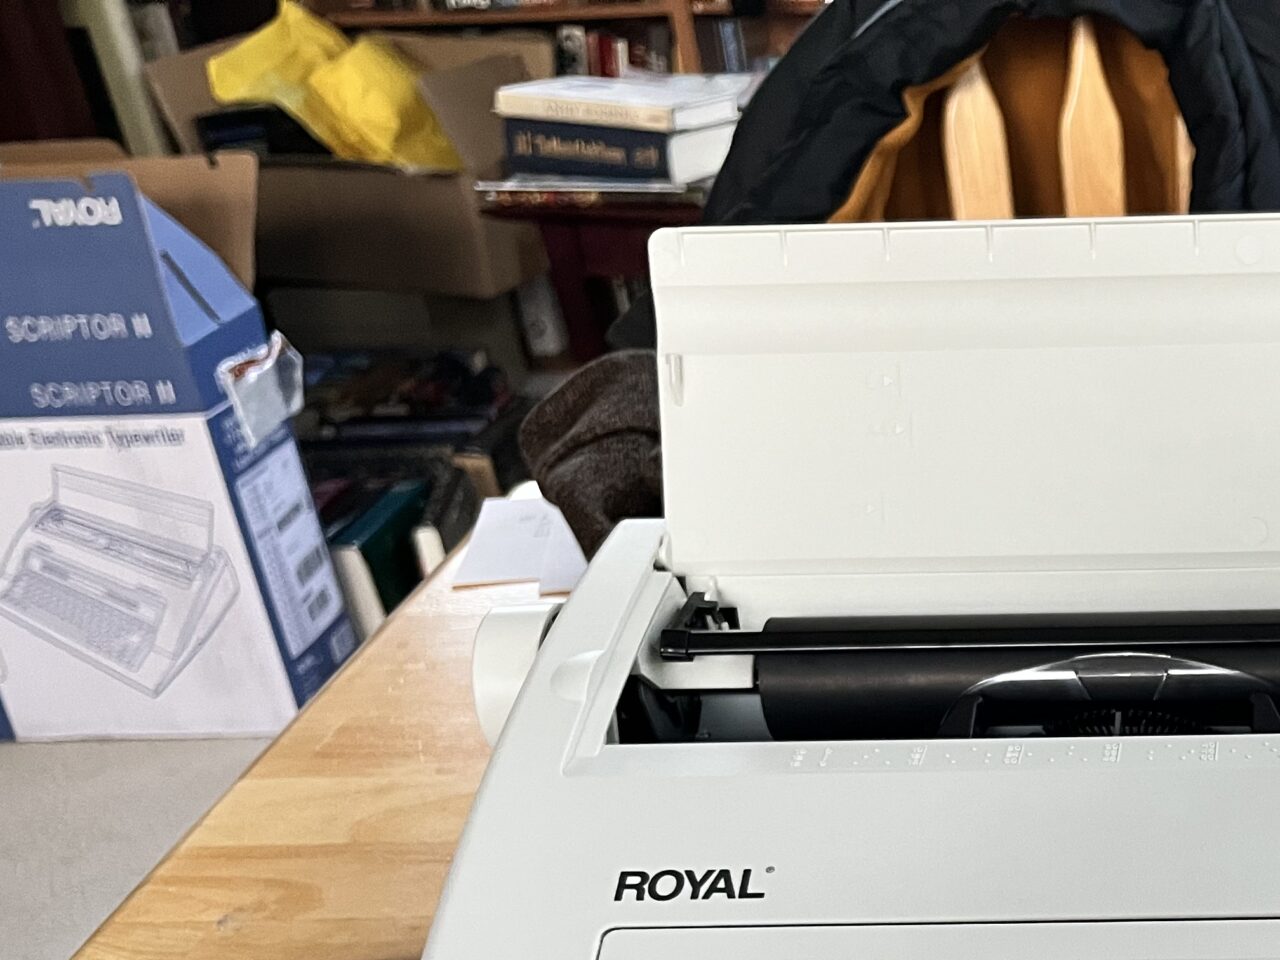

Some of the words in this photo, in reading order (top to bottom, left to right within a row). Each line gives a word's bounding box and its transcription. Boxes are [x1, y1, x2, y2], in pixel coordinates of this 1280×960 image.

[29, 197, 123, 226] ROYAL
[5, 313, 128, 343] SCRIPTOR
[30, 380, 151, 408] SCRIPTOR
[614, 869, 764, 901] ROYAL
